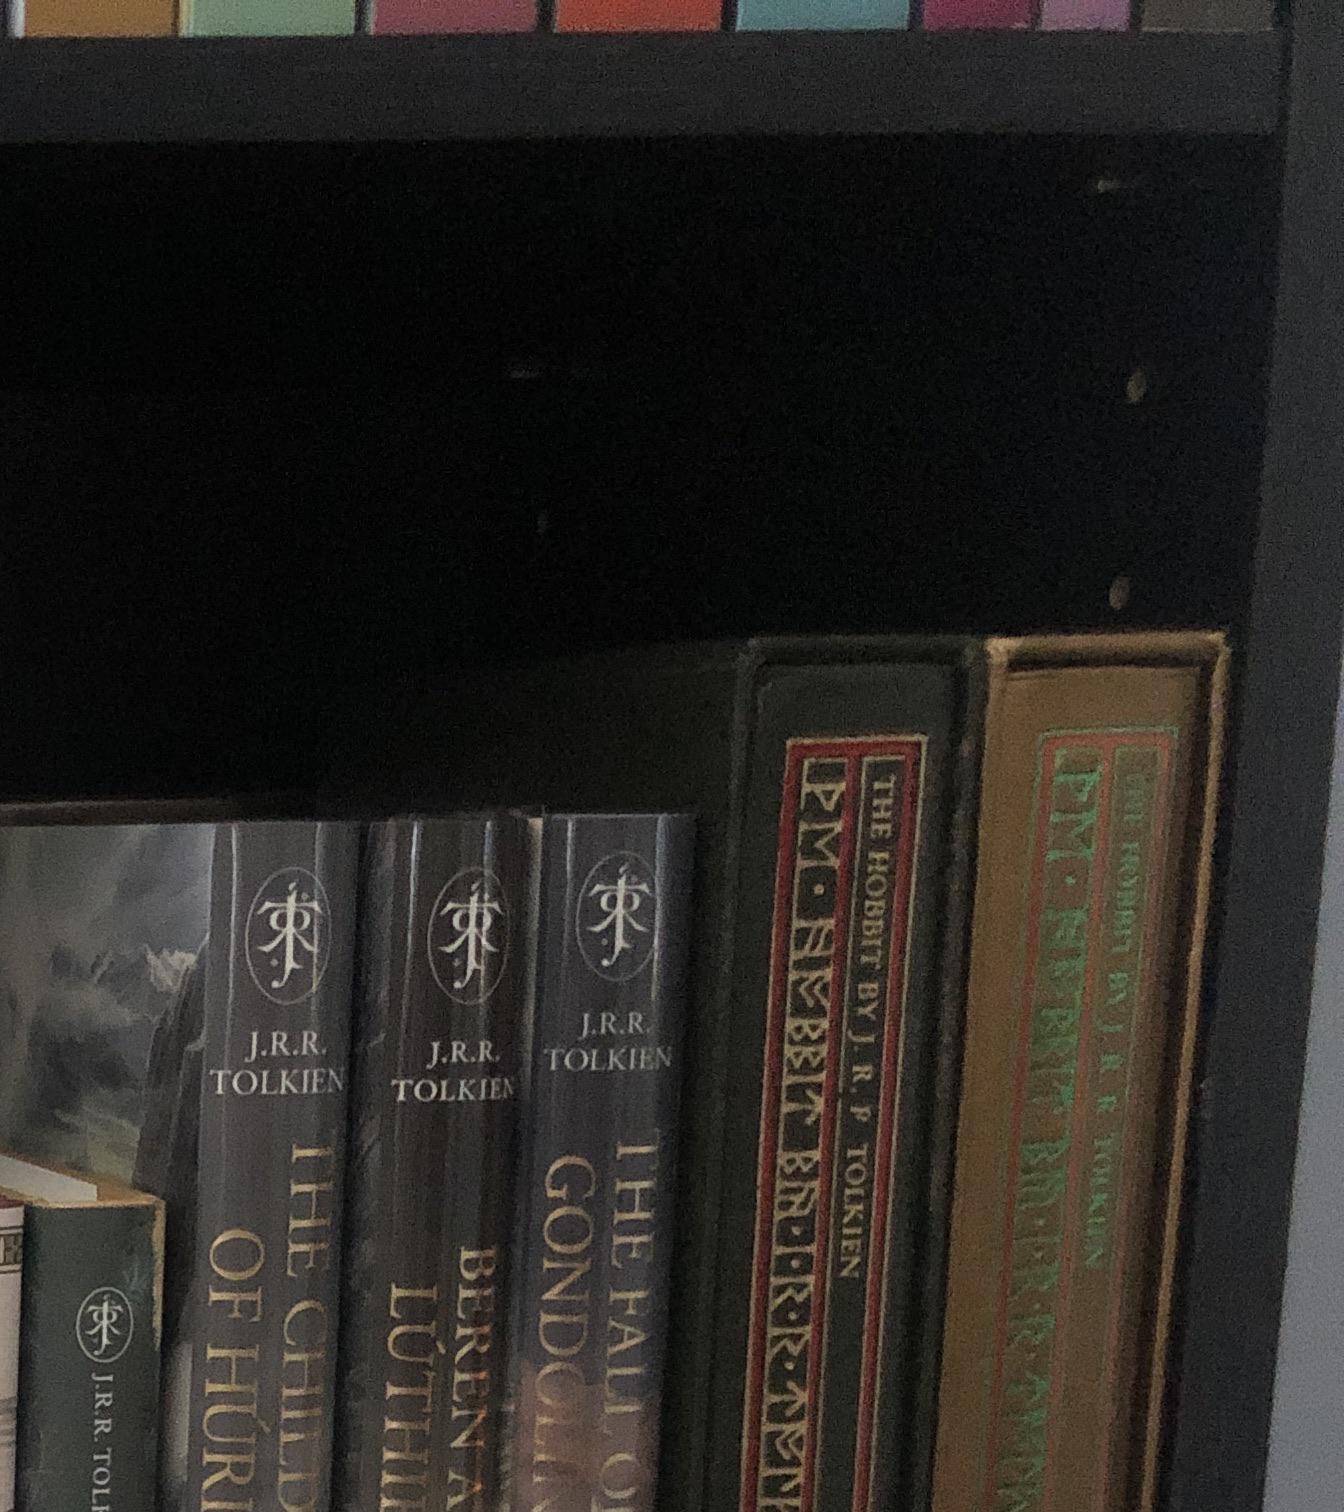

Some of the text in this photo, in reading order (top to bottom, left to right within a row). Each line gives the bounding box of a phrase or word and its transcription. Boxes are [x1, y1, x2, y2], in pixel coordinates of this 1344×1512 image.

[576, 1012, 652, 1042] J.R.R.
[839, 773, 896, 1278] THE HOBBIT TOLKIEN
[245, 1030, 327, 1062] J.R.R.
[425, 1040, 501, 1070] J.R.R.
[544, 1046, 672, 1073] TOLKIEN
[209, 1066, 346, 1096] TOLKIEN
[391, 1076, 515, 1104] TOLKIEN
[612, 1129, 658, 1269] THE
[207, 1228, 265, 1323] OF
[449, 1245, 499, 1449] BEREN
[91, 1372, 113, 1443] J.R.R.
